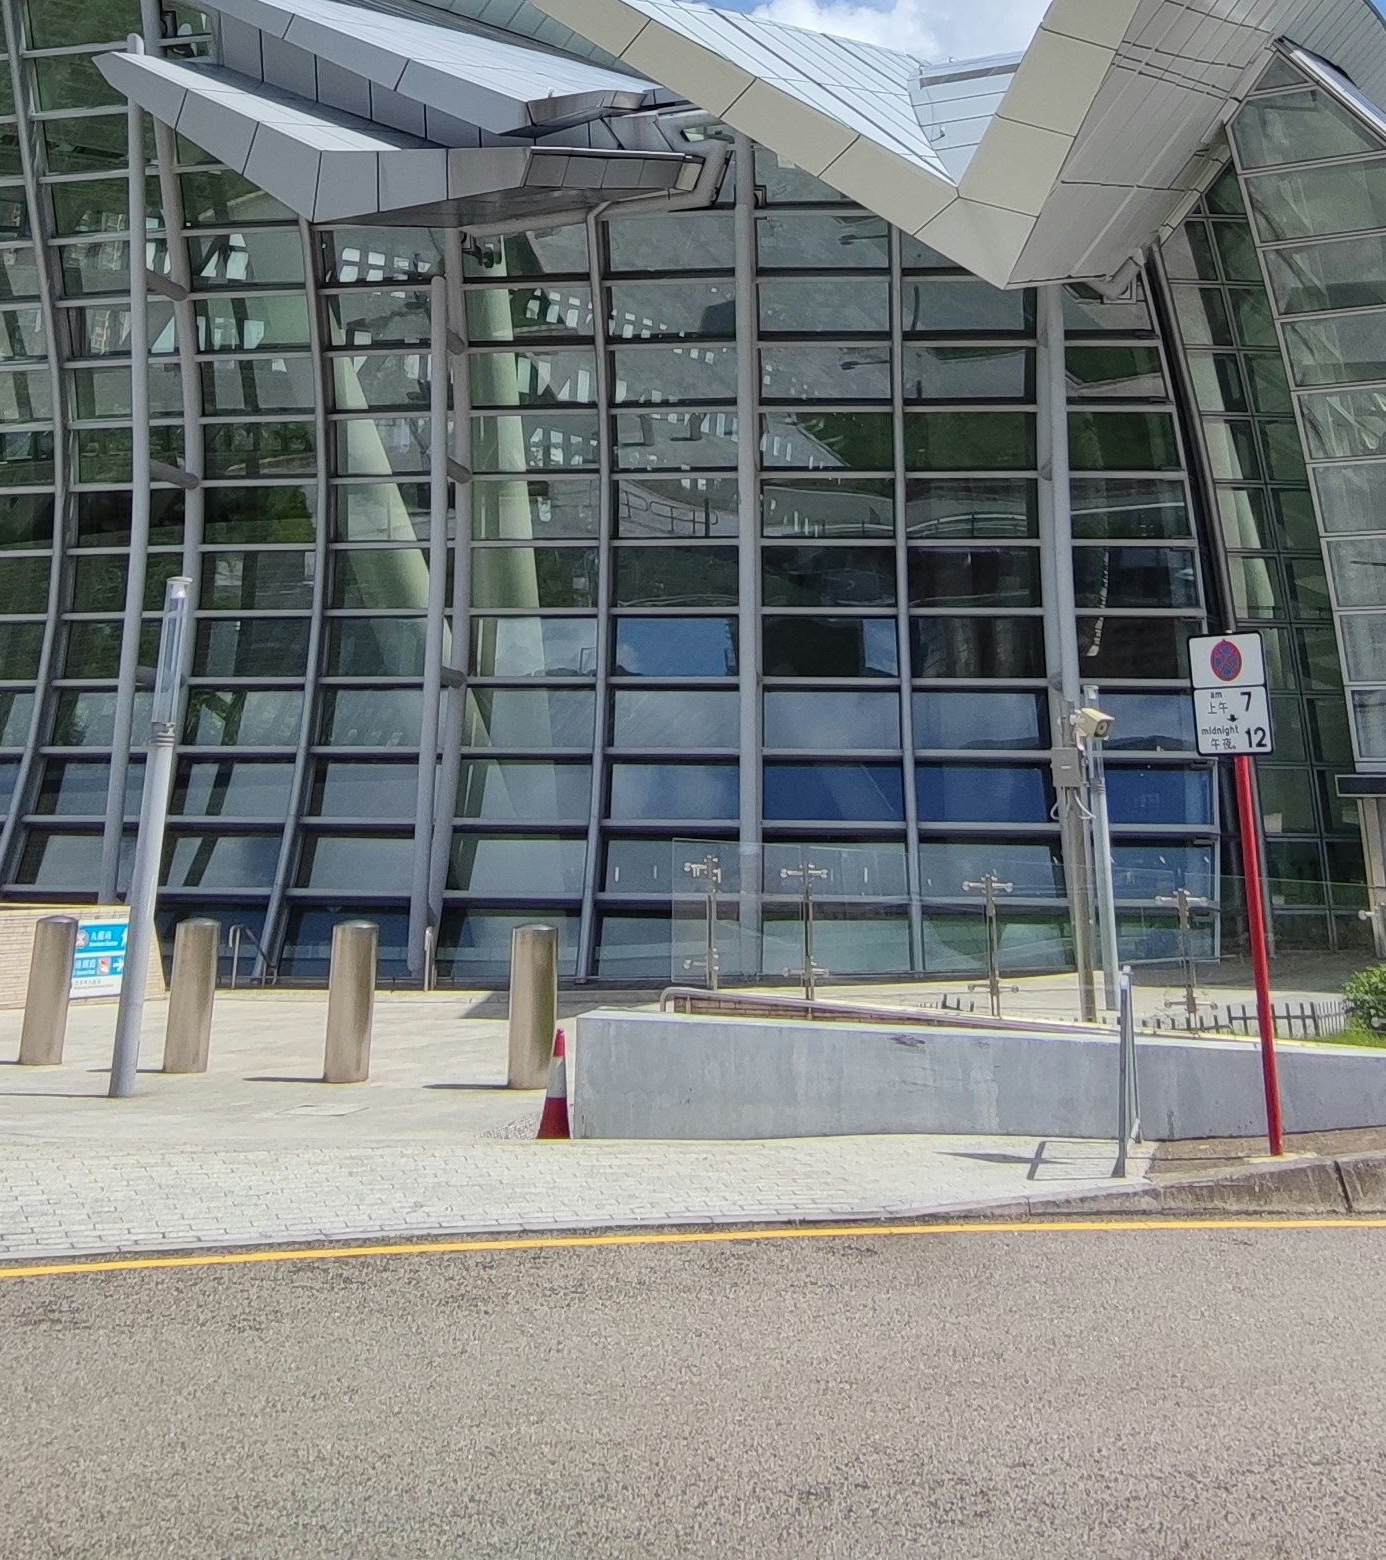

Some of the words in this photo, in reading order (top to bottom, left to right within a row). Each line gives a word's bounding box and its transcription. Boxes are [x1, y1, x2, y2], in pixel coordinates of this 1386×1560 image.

[1240, 691, 1252, 712] 7
[1207, 702, 1229, 715] 上午
[1201, 725, 1240, 736] midnight
[1244, 726, 1268, 748] 12
[1211, 738, 1233, 750] 午夜
